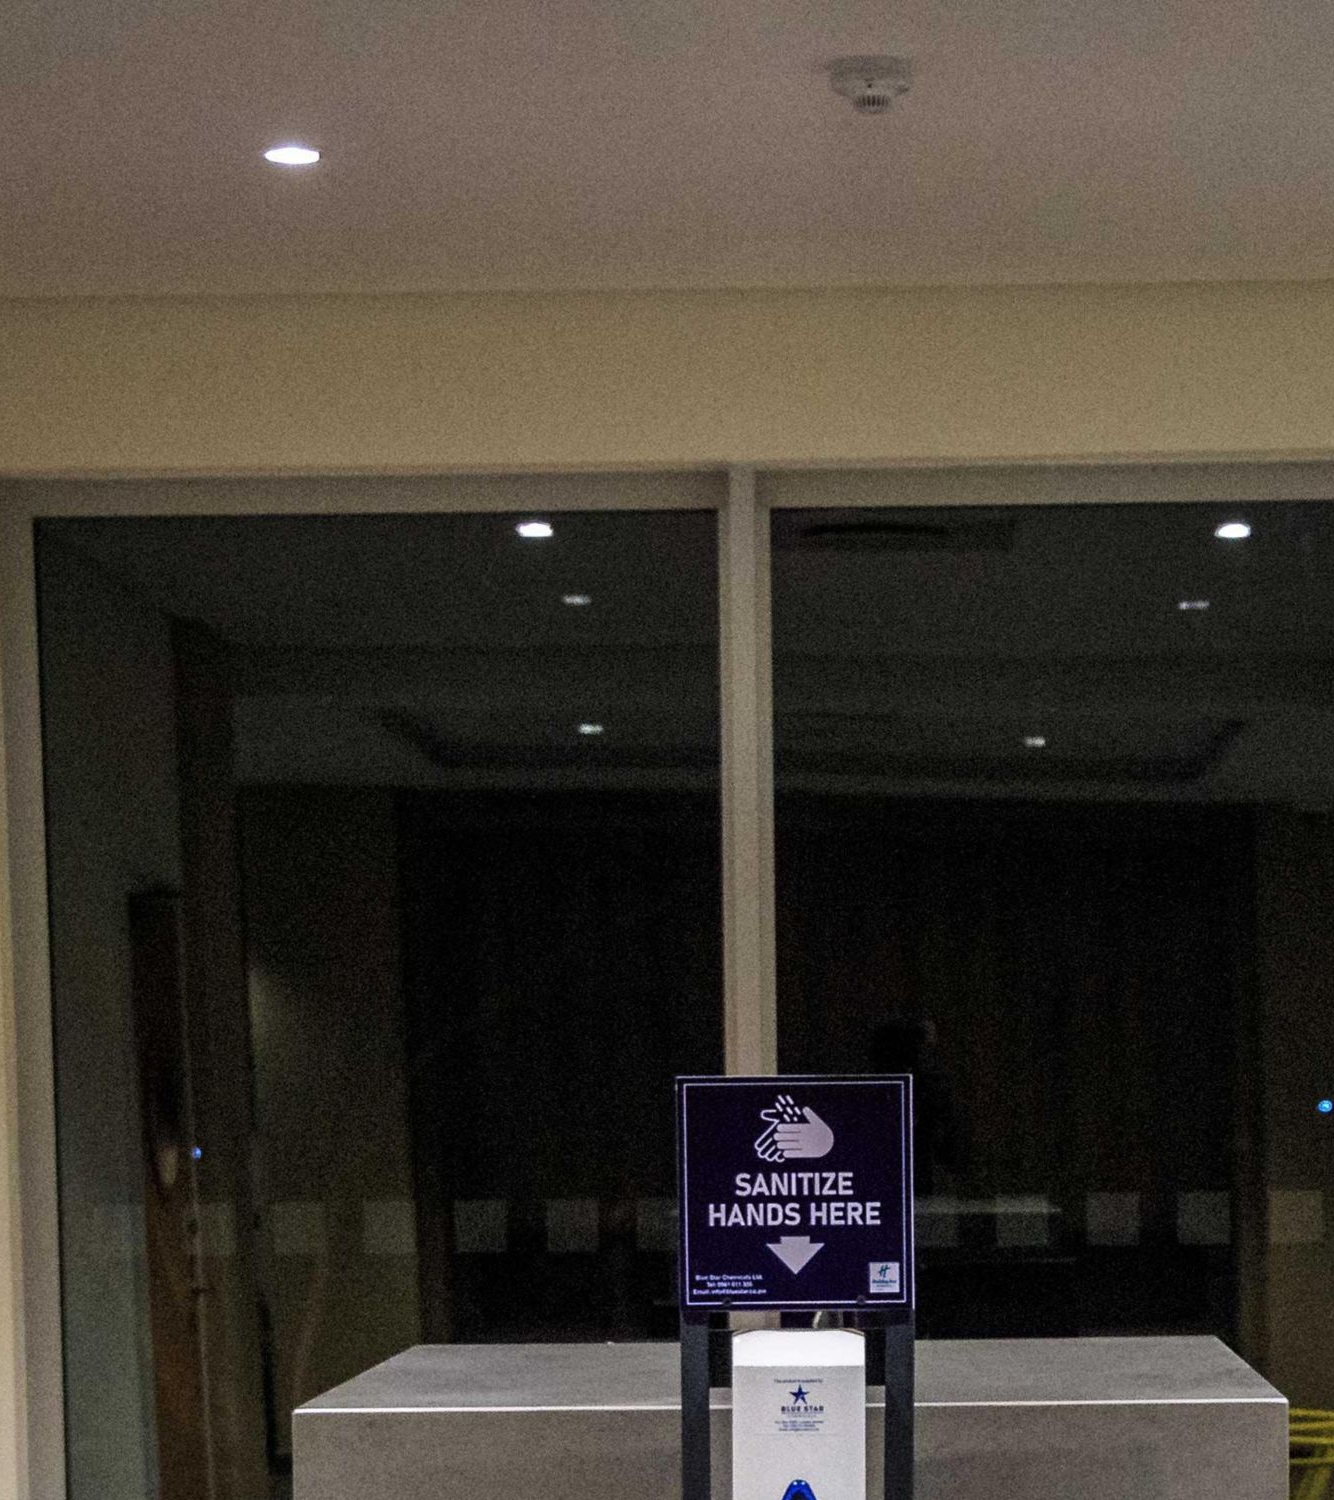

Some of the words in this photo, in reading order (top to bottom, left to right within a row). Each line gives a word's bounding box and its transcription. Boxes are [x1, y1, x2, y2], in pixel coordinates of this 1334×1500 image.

[735, 1172, 854, 1197] SANITIZE
[708, 1203, 801, 1227] HANDS
[809, 1202, 881, 1226] HERE
